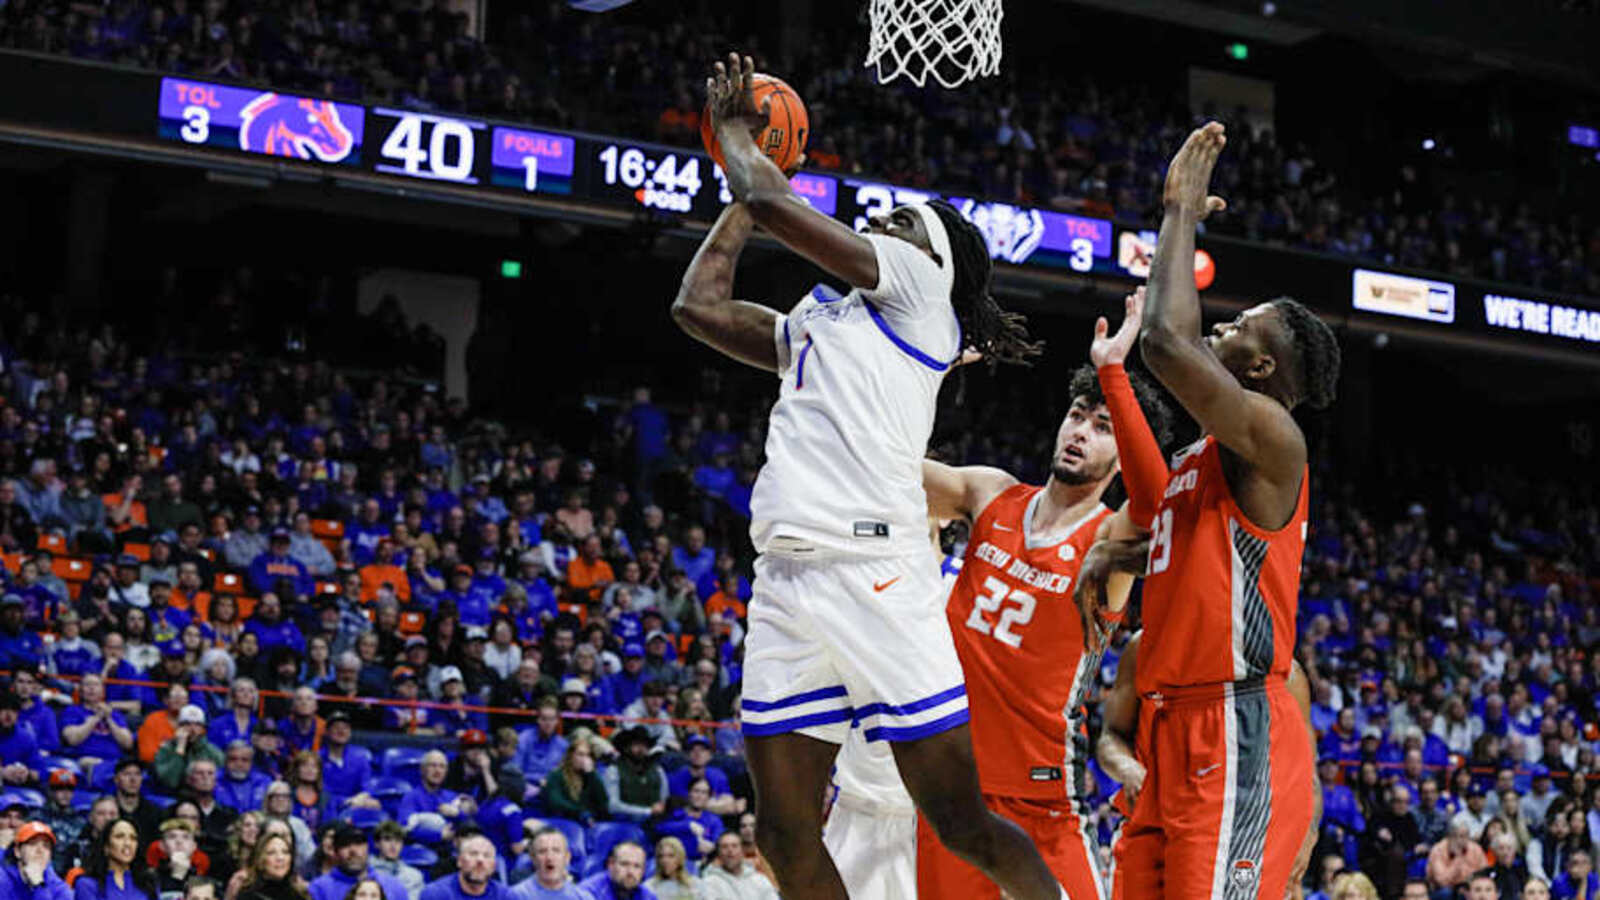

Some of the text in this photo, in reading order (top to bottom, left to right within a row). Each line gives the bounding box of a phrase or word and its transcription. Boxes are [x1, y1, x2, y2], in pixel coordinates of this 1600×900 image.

[175, 84, 221, 108] TOL
[181, 105, 210, 143] 3
[380, 115, 475, 180] 40
[504, 134, 563, 157] FOULS
[521, 156, 538, 191] 1
[600, 145, 701, 196] 16:44
[644, 189, 691, 212] POSS
[1066, 220, 1101, 240] TOL
[1070, 238, 1093, 272] 3
[1485, 294, 1549, 333] WE'RE
[975, 542, 1071, 594] NEW MEXICO
[966, 575, 1037, 648] 22
